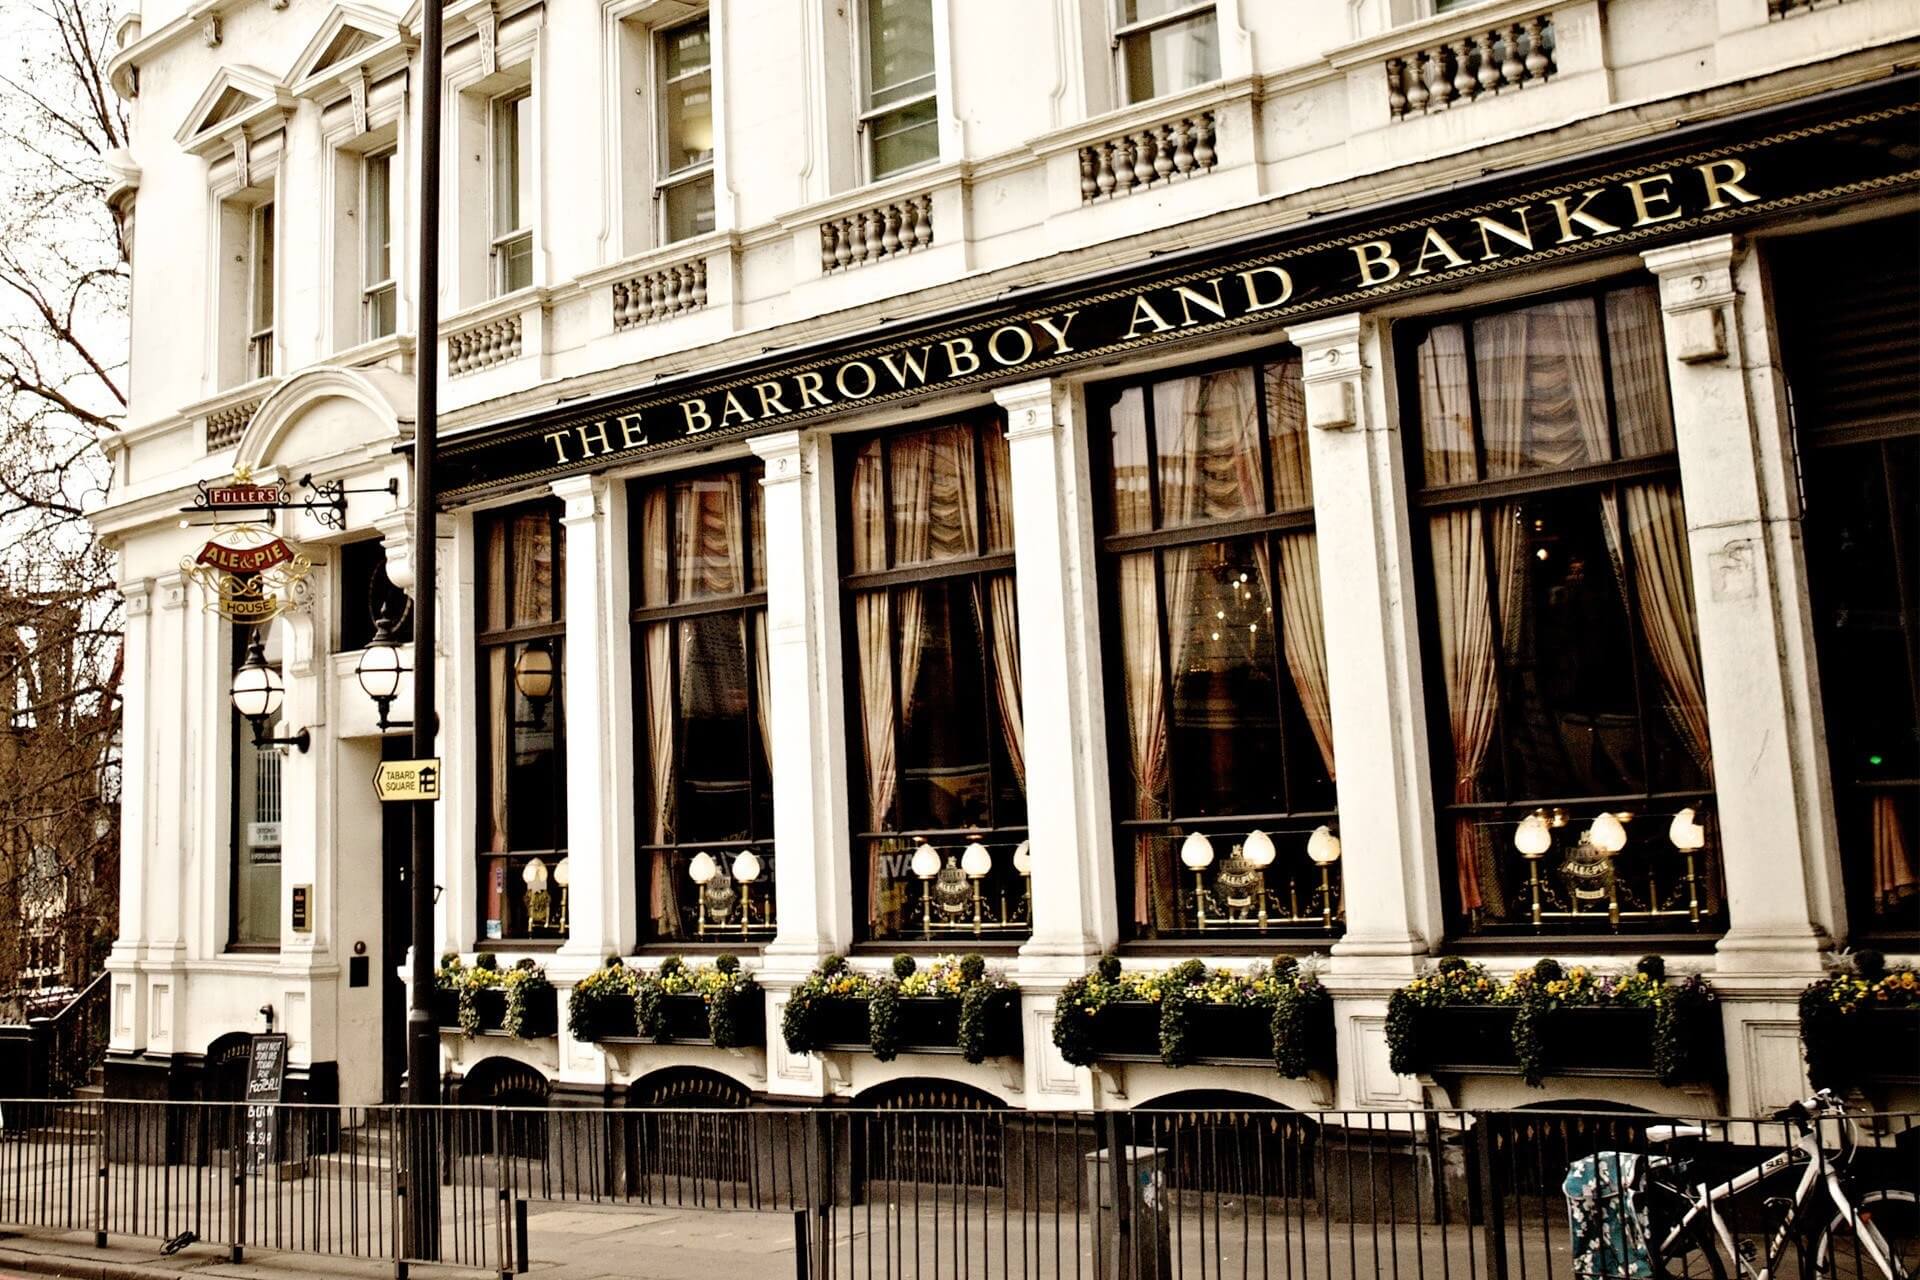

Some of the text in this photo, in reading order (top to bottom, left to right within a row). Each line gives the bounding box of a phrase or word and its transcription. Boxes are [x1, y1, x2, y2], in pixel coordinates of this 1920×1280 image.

[543, 412, 649, 464] THE
[1122, 265, 1295, 339] AND
[1348, 157, 1761, 289] BANKER
[227, 600, 272, 613] HOUSE
[386, 770, 416, 780] TABARD
[385, 781, 416, 791] SQUARE
